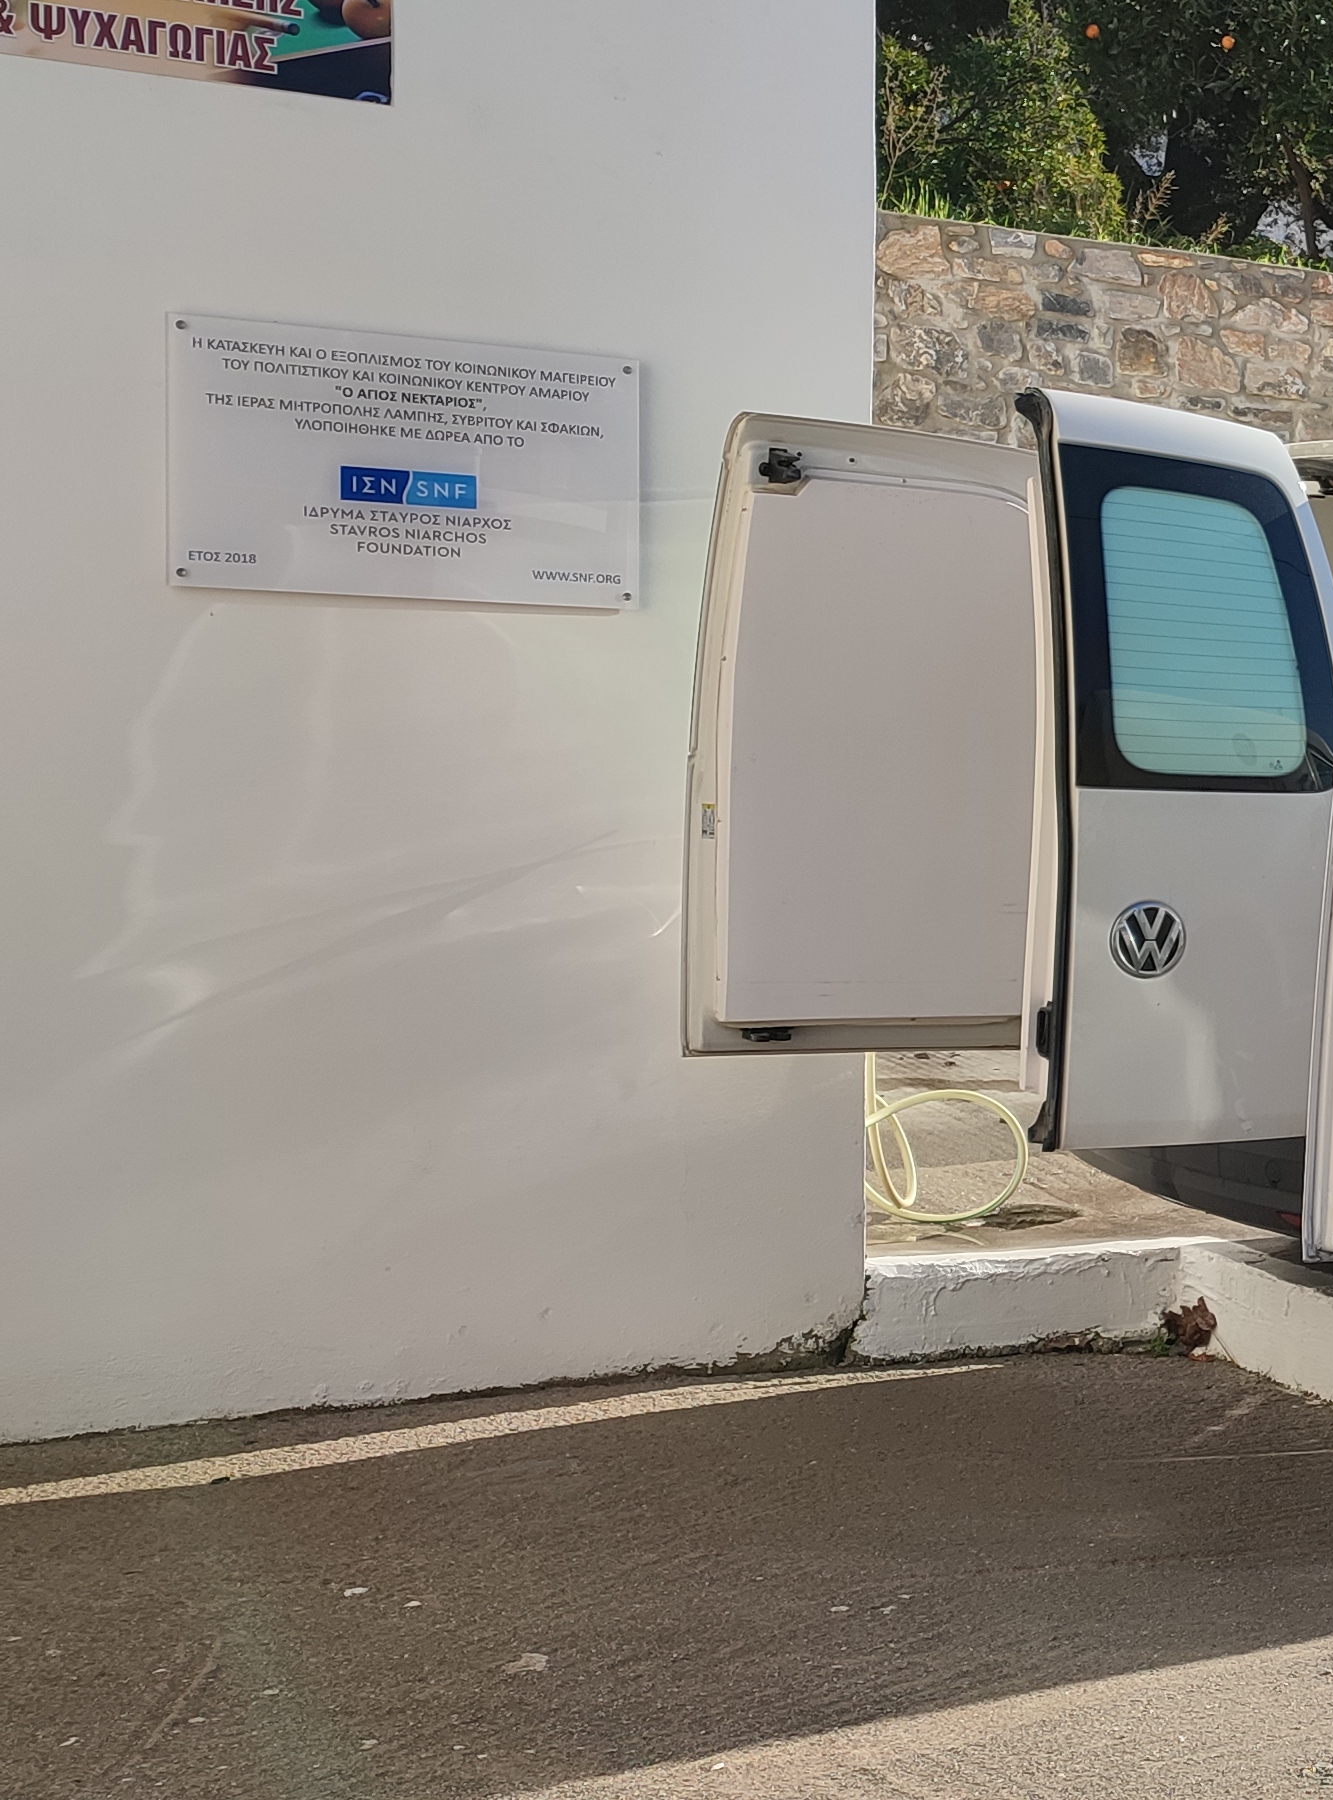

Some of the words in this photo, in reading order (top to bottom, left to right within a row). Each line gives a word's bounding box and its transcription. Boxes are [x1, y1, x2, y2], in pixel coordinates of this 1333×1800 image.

[29, 1, 277, 73] ΨΥΧΑΓΩΓΙΑΣ
[192, 337, 202, 348] Η
[207, 338, 285, 356] ΚΑΤΑΣΚΕΥΗ
[290, 346, 312, 359] ΚΑΙ
[331, 350, 421, 370] ΕΞΟΠΛΙΣΜΟΣ
[425, 358, 451, 372] ΤΟΥ
[455, 362, 536, 381] ΚΟΙΝΩΝΙΚΟΥ
[540, 371, 616, 388] ΜΑΓΕΙΡΕΙΟΥ
[222, 358, 250, 371] ΤΟΥ
[254, 361, 349, 380] ΠΟΛΙΤΙΣΤΙΚΟΥ
[352, 370, 374, 382] ΚΑΙ
[379, 373, 462, 392] ΚΟΙΝΩΝΙΚΟΥ
[466, 381, 526, 397] ΚΕΝΤΡΟΥ
[529, 387, 590, 402] ΑΜΑΡΙΟΥ
[357, 388, 398, 402] ΑΓΙΟΣ
[205, 392, 234, 406] ΤΗΣ
[237, 395, 275, 409] ΙΕΡΑΣ
[279, 399, 381, 419] ΜΗΤΡΟΠΟΛΗΣ
[384, 407, 448, 425] ΛΑΜΠΗΣ,
[451, 414, 513, 430] ΣΥΒΡΙΤΟΥ
[516, 420, 537, 432] ΚΑΙ
[540, 421, 604, 439] ΣΦΑΚΙΩΝ,
[294, 418, 396, 437] ΥΛΟΠΟΙΗΘΗΚΕ
[400, 427, 421, 439] ΜΕ
[425, 430, 471, 444] ΔΩΡΕΑ
[473, 433, 504, 446] ΑΠΟ
[507, 436, 525, 448] ΤΟ
[352, 475, 397, 495] ΙΣΝ
[415, 480, 467, 500] SNF
[303, 505, 365, 521] ΙΔΡΥΜΑ
[369, 510, 441, 526] ΣΤΑΥΡΟΣ
[446, 516, 512, 531] ΝΙΑΡΧΟΣ
[329, 523, 400, 539] STAVROS
[405, 528, 487, 545] NIARCHOS
[188, 550, 221, 562] ΕΤΟΣ
[224, 552, 257, 564] 2018
[357, 541, 461, 558] FOUNDATION
[532, 569, 622, 585] WWW.SNF.ORG
